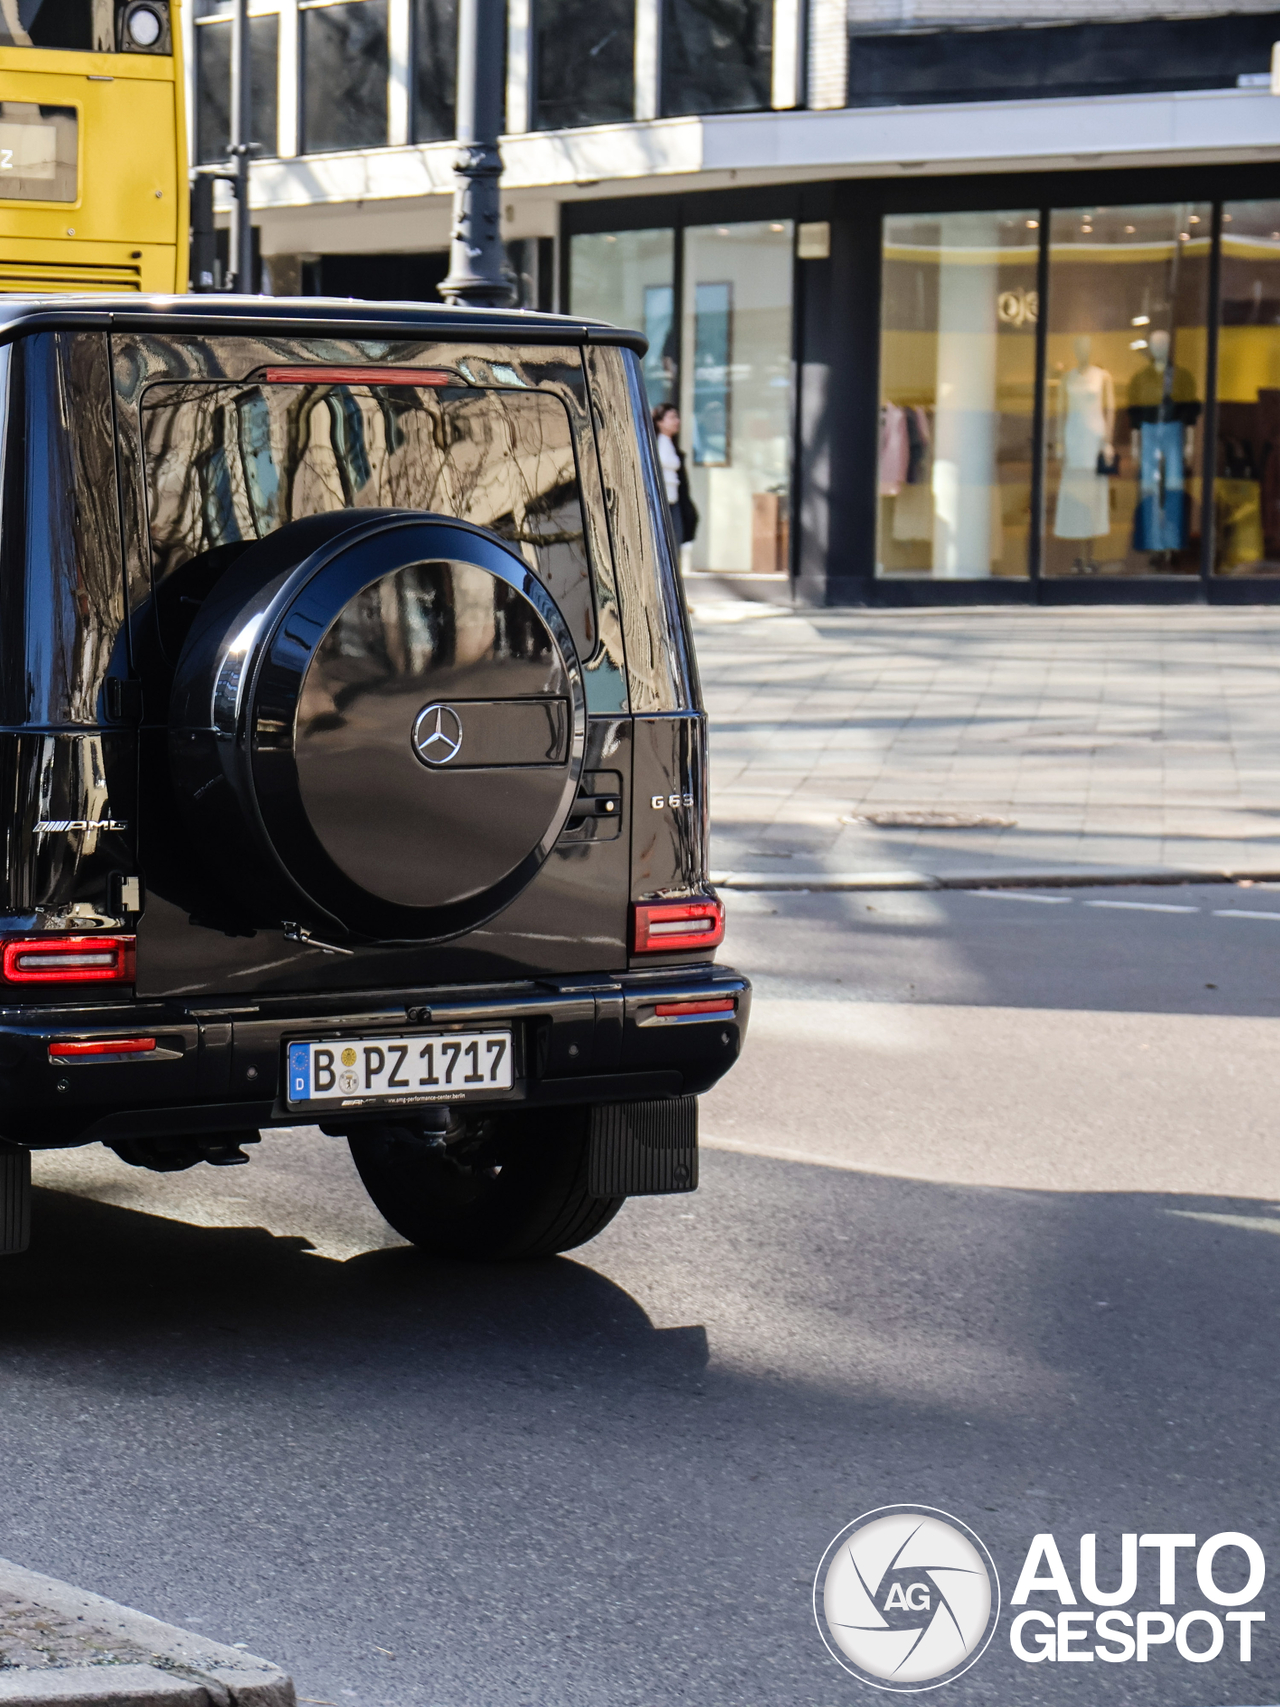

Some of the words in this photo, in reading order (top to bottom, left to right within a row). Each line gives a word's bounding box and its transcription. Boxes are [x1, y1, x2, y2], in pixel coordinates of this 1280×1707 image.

[314, 1049, 336, 1092] B
[363, 1045, 410, 1089] PZ
[419, 1039, 507, 1086] 1717
[296, 1078, 304, 1091] D
